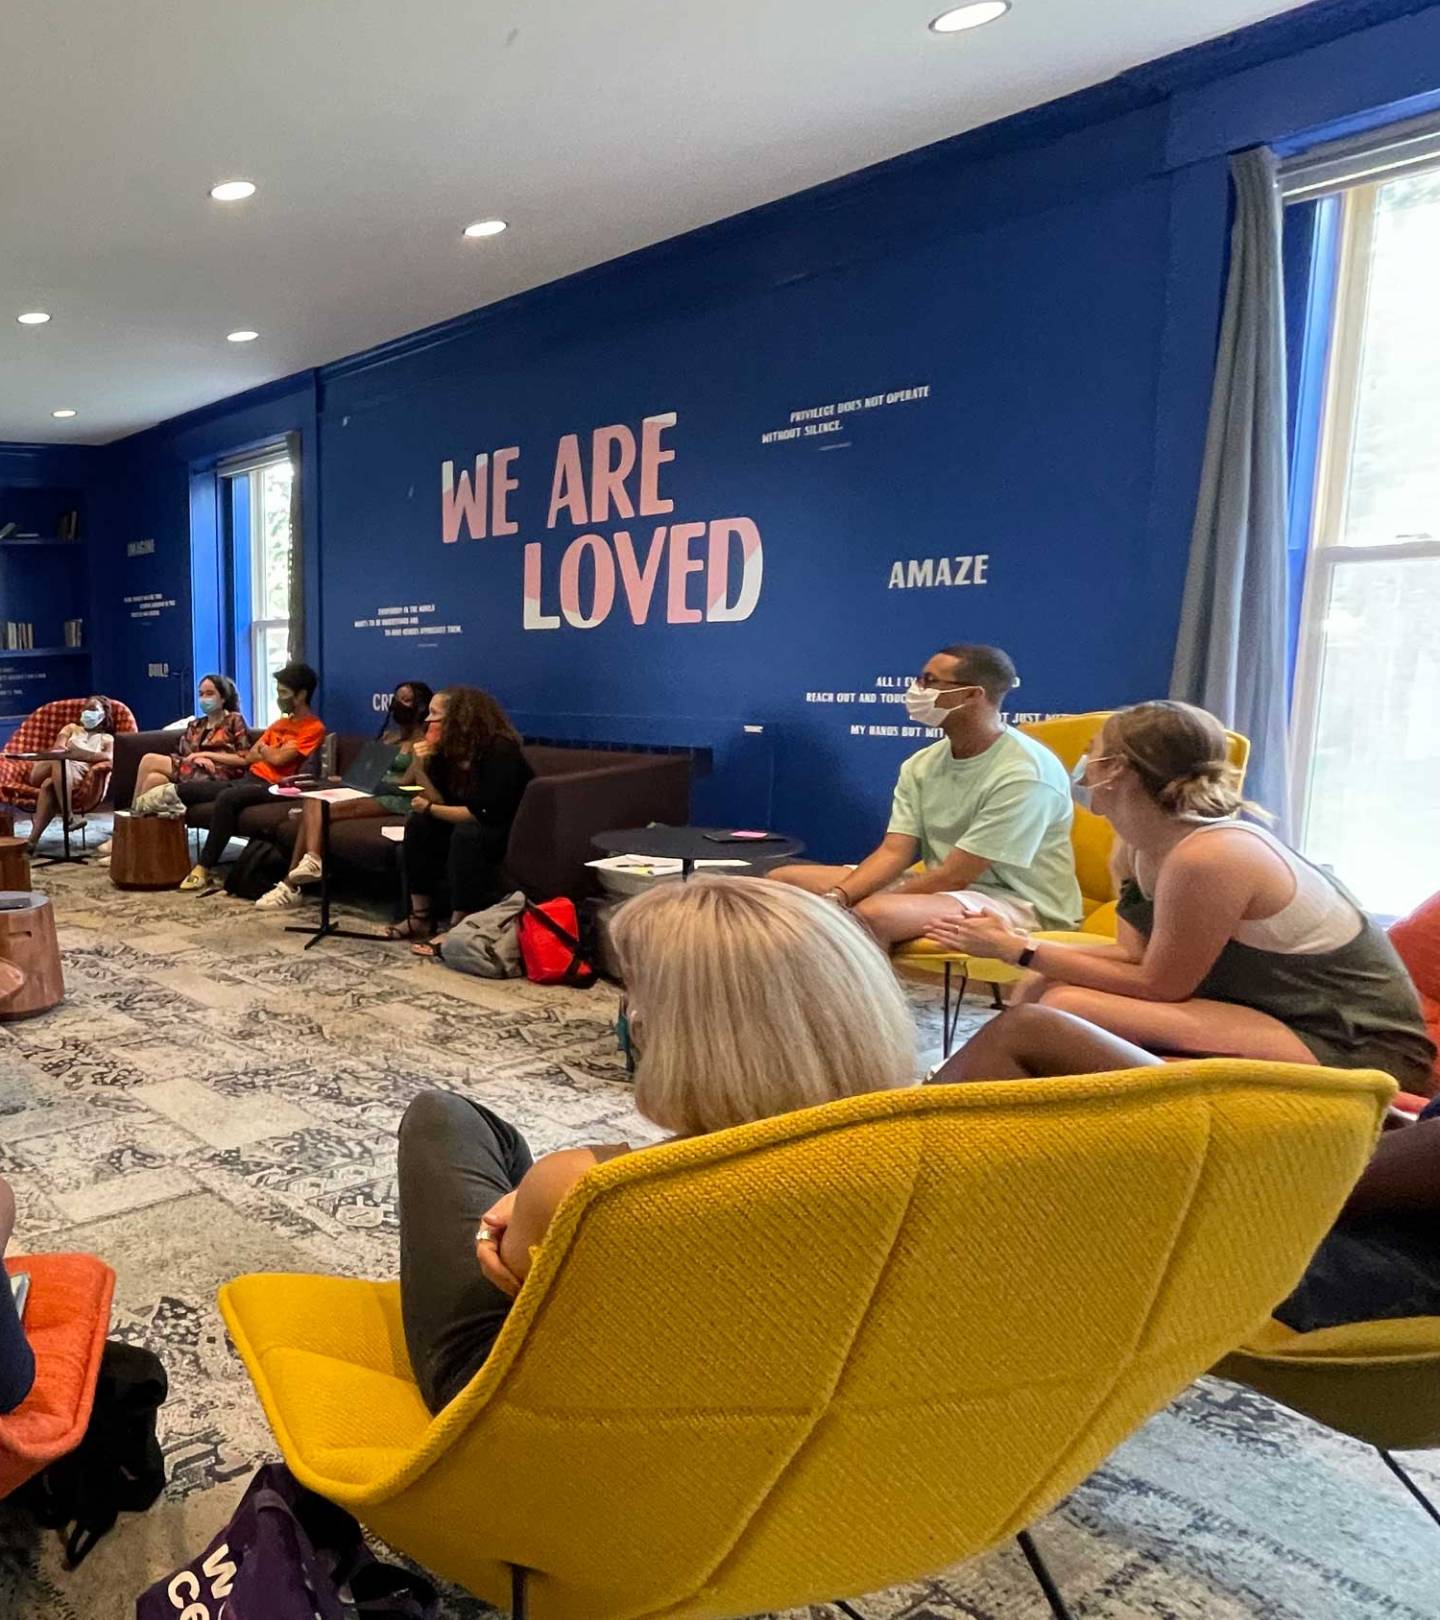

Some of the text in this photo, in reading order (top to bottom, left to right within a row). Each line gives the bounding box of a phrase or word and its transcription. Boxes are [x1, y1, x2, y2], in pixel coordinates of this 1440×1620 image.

[790, 385, 930, 423] PRIVILEGE DOES NOT OPERATE
[761, 427, 802, 444] WITHOUT
[441, 411, 678, 544] WE ARE
[523, 516, 764, 631] LOVED
[888, 554, 989, 589] AMAZE
[875, 676, 894, 687] ALL
[806, 692, 907, 704] REACH OUT AND TOUC
[850, 725, 944, 738] MY HANDS BUT WIT
